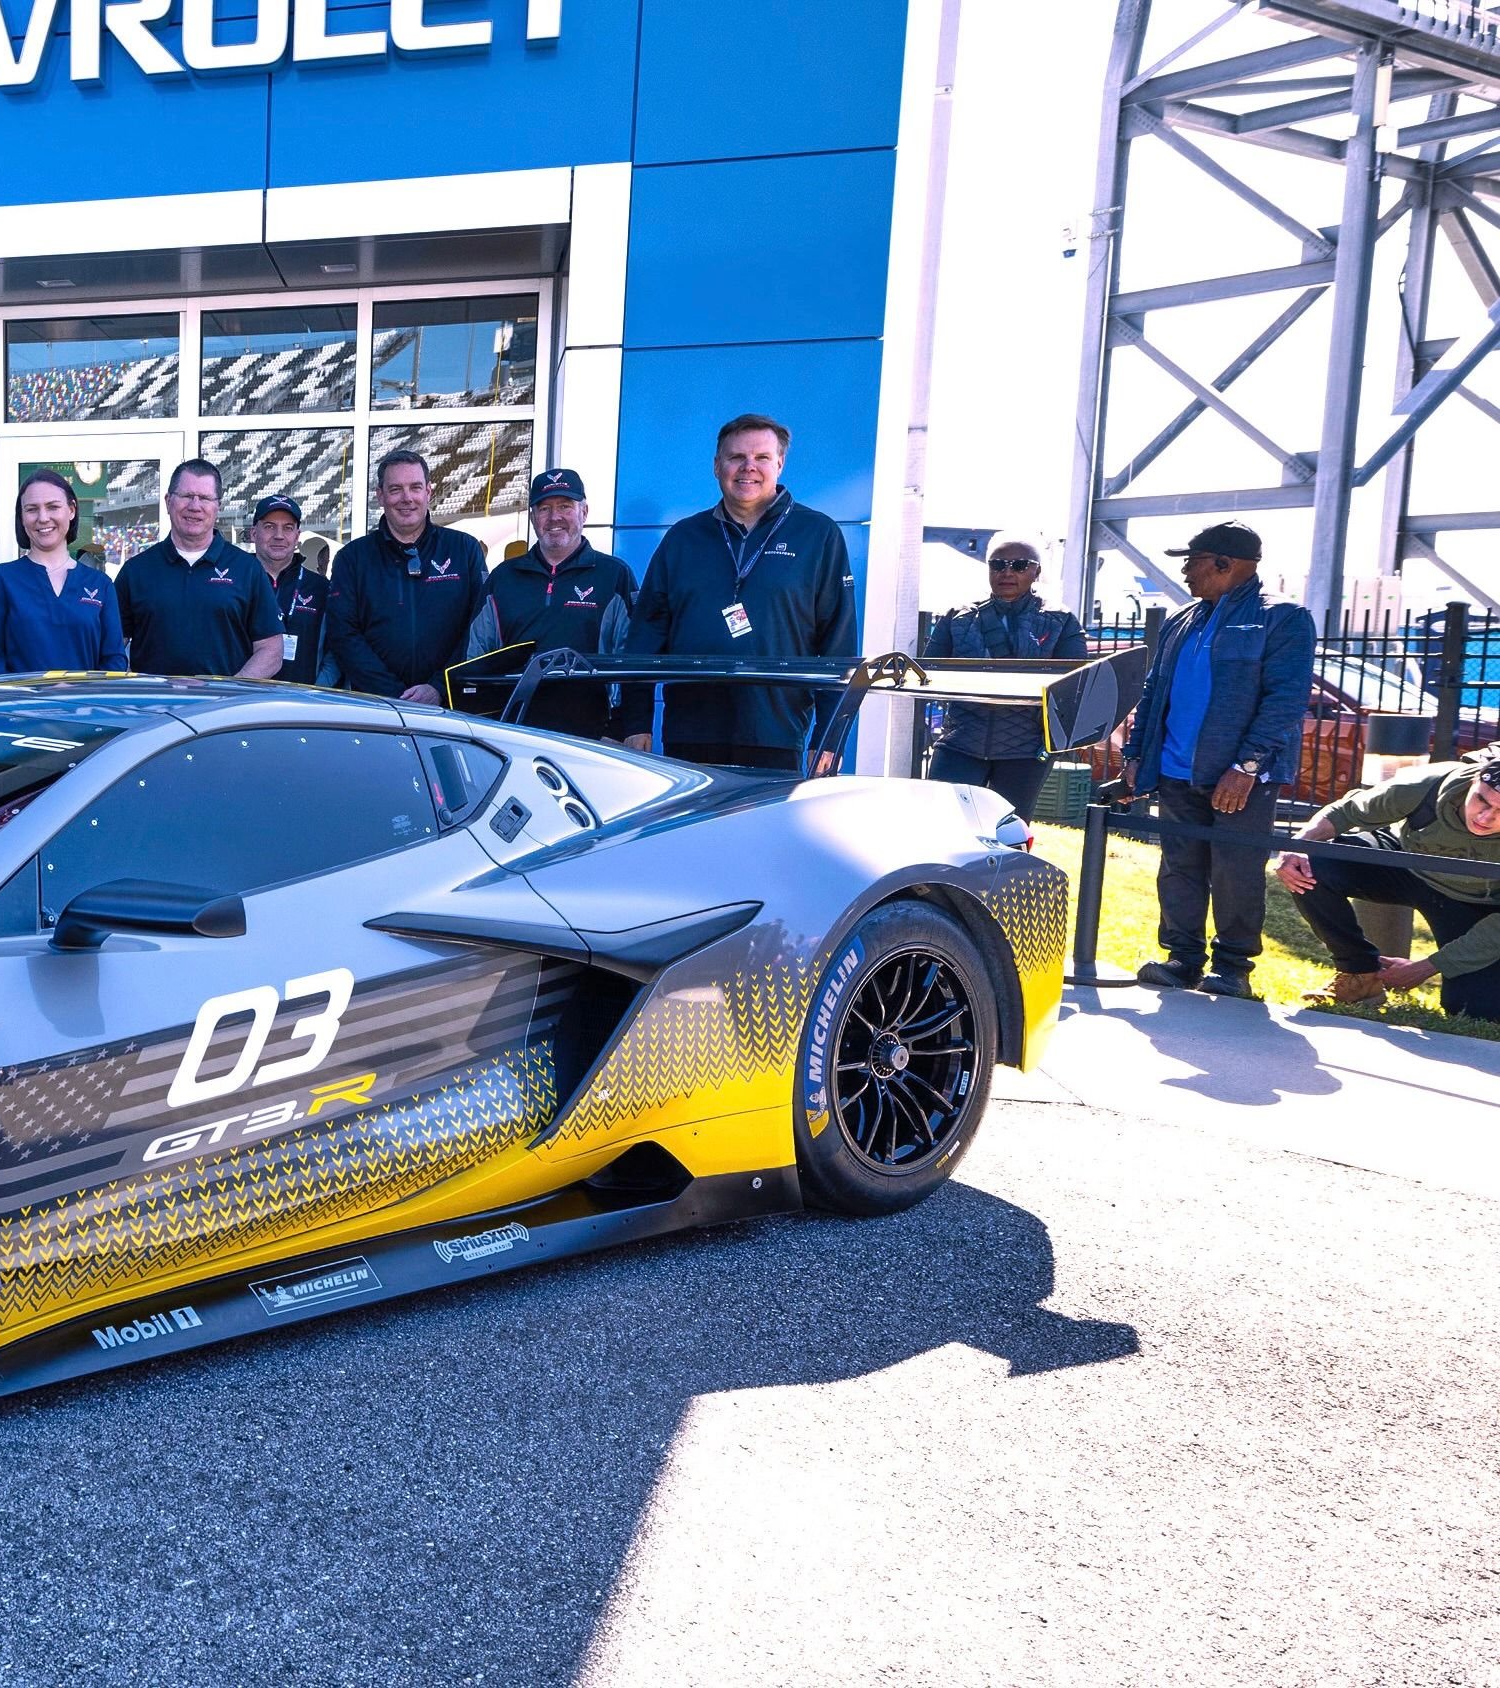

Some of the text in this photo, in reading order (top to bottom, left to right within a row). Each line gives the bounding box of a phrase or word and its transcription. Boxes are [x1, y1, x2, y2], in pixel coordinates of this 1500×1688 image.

[167, 967, 355, 1108] 03
[809, 948, 859, 1084] MICHELIN
[293, 1268, 369, 1297] MICHELIN
[92, 1313, 175, 1350] Mobil
